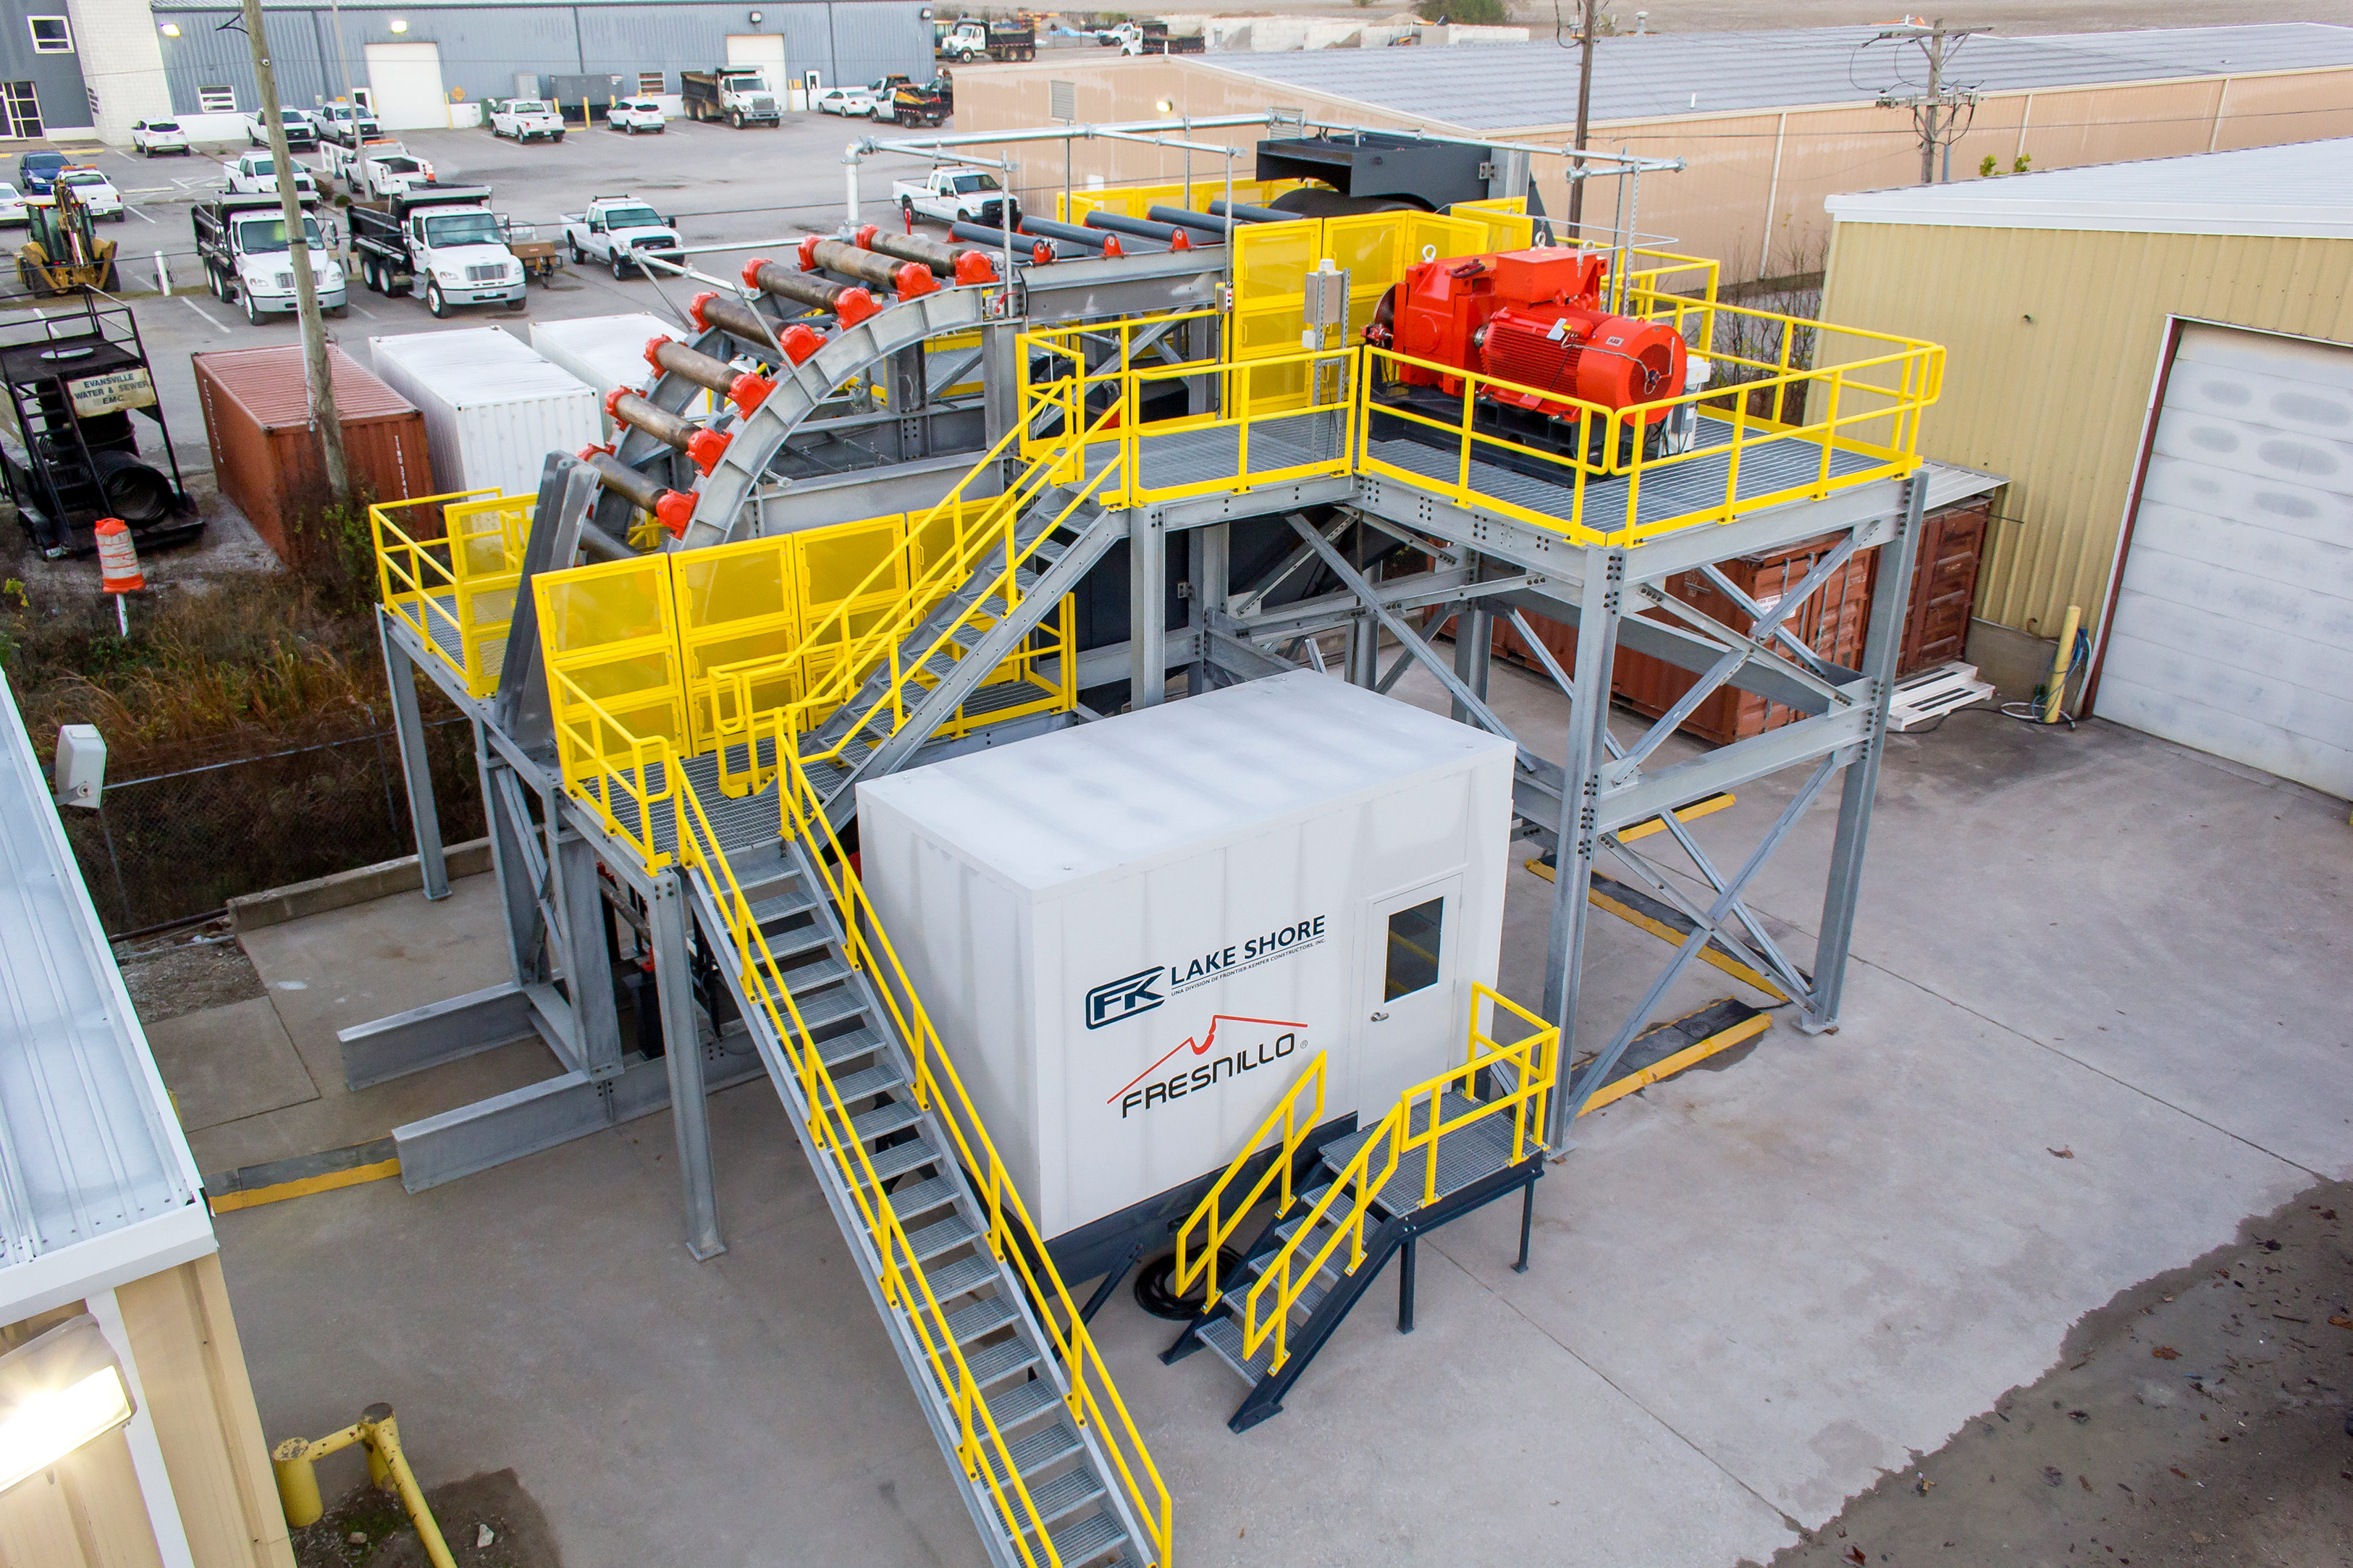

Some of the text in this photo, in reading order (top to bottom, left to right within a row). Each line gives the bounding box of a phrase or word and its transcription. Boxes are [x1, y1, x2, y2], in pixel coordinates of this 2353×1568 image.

[75, 388, 104, 400] WATER
[119, 381, 149, 392] SEWER
[84, 373, 134, 388] EVANSVILLE
[103, 395, 124, 405] EMC
[1171, 914, 1326, 986] LAKE SHORE
[1171, 988, 1184, 997] UNA
[1185, 979, 1211, 992] DIVISIÓN
[1219, 958, 1270, 979] FRONTIER-KEMPER
[1270, 944, 1315, 961] CONSTRUCTORS,
[1093, 972, 1164, 1022] FK
[1121, 1032, 1295, 1119] FRESNILLO
